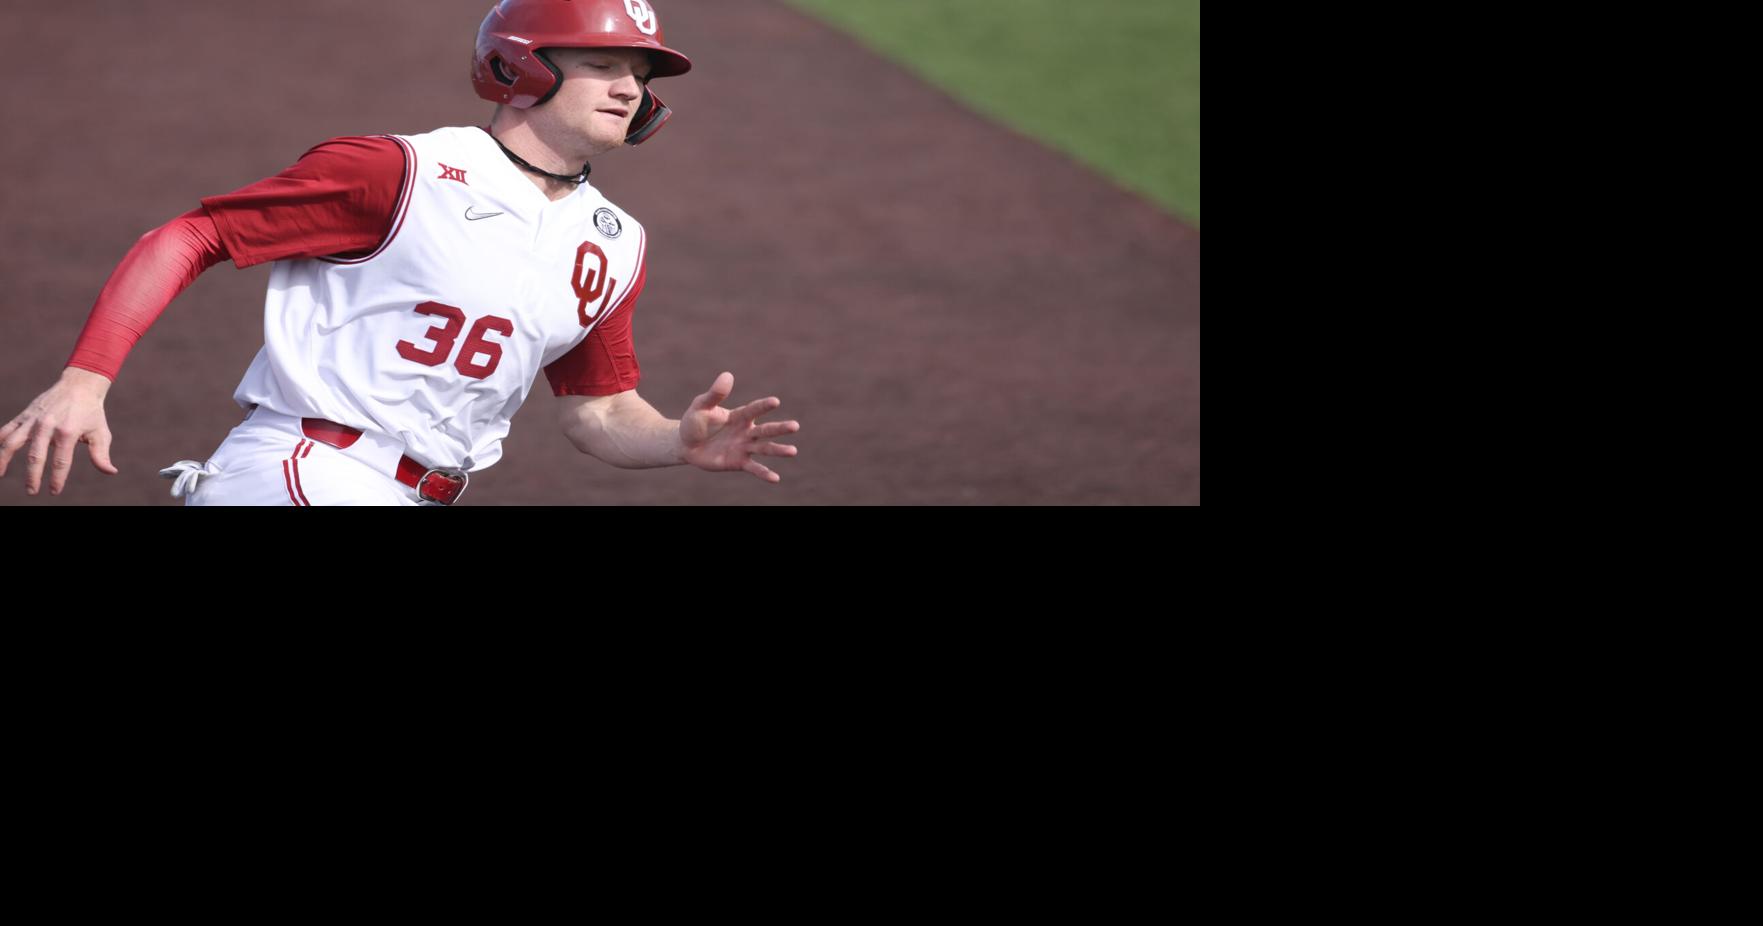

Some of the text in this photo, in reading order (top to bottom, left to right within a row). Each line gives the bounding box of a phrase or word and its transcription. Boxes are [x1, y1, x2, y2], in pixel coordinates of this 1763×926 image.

[623, 0, 657, 35] OU
[437, 162, 469, 186] XII
[571, 240, 617, 329] OU
[395, 300, 514, 380] 36
